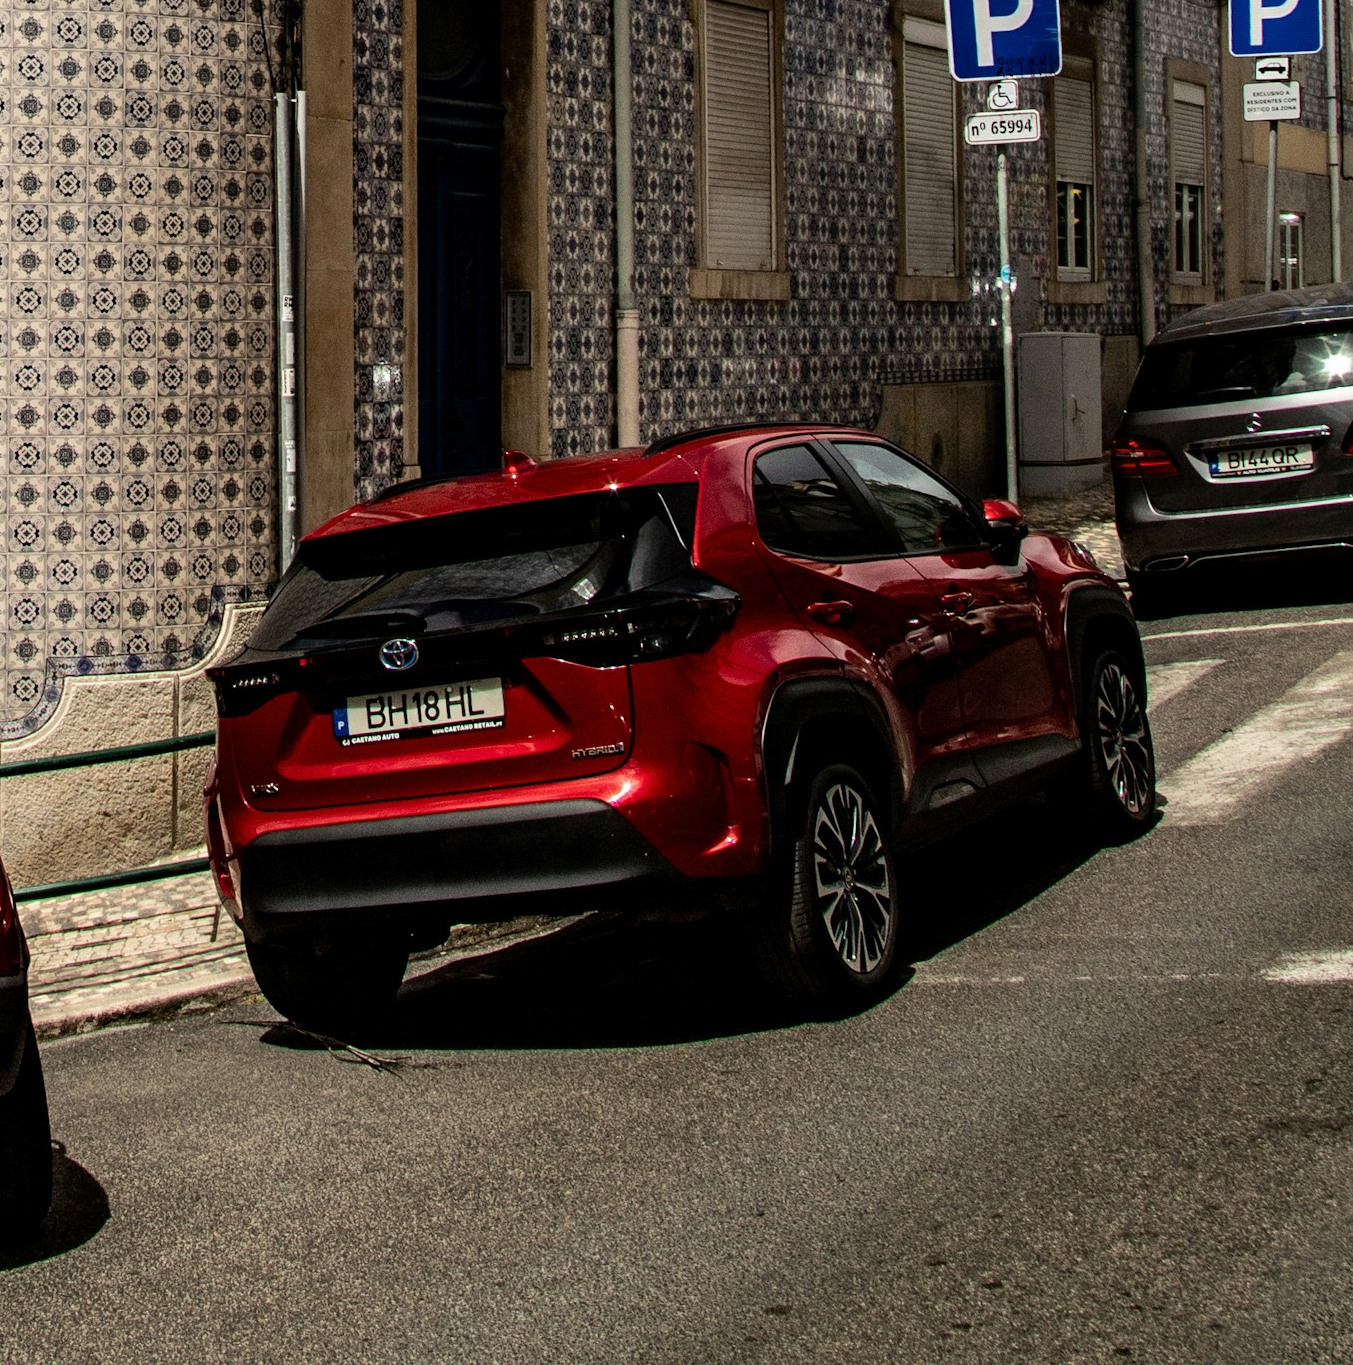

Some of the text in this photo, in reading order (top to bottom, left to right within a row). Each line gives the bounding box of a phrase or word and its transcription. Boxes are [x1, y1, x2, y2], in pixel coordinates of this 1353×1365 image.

[990, 118, 1033, 136] 65994
[337, 721, 345, 730] P
[351, 732, 400, 744] CAETANO AUTO
